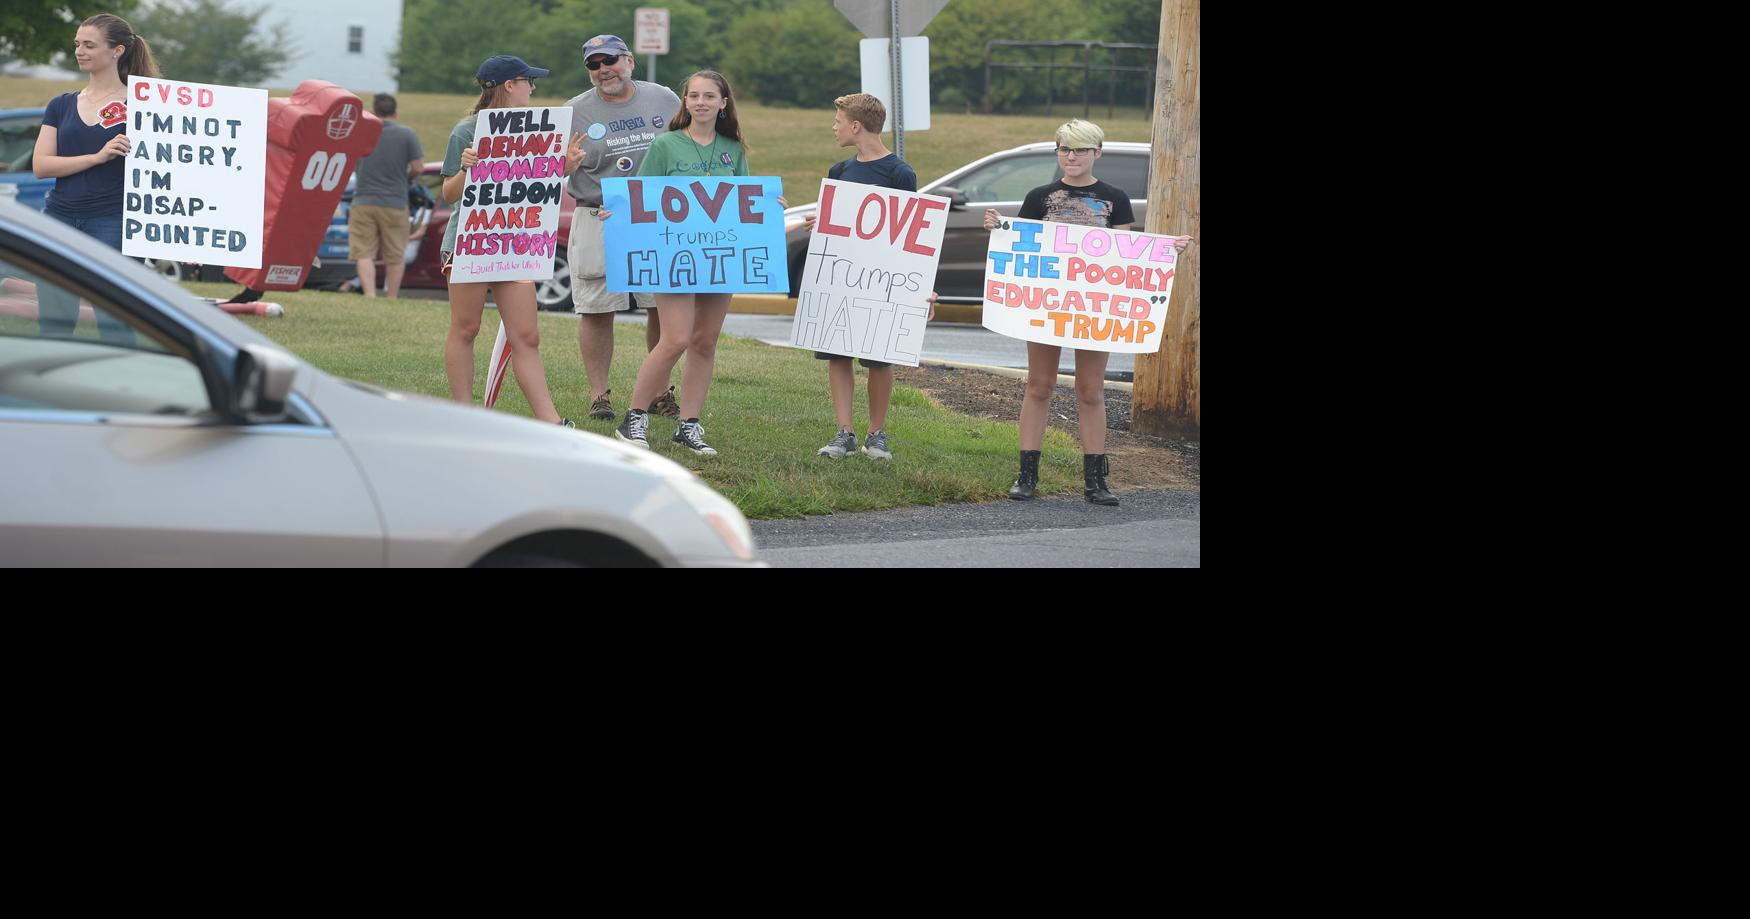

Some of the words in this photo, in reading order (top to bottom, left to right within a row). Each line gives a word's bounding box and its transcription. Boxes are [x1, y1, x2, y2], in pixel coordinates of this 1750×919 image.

[134, 82, 214, 108] CVSD
[134, 111, 173, 133] I'M
[182, 116, 242, 139] NOT
[488, 109, 556, 135] WELL
[608, 116, 646, 133] RISK
[477, 133, 563, 160] BEHAVED
[606, 136, 630, 147] Risking
[630, 133, 641, 142] the
[132, 168, 171, 190] I'M
[301, 150, 347, 192] 00
[470, 155, 567, 184] WOMEN
[126, 192, 217, 217] DISAP-
[462, 181, 562, 208] SELDOM
[627, 179, 764, 225] LOVE
[464, 206, 543, 232] MAKE
[817, 184, 947, 257] LOVE
[125, 218, 247, 252] POINTED
[455, 229, 558, 258] HISTORY
[658, 225, 738, 246] trumps
[1053, 225, 1176, 264] LOVE
[627, 246, 769, 288] HATE
[809, 237, 923, 302] trumps
[988, 250, 1060, 279] THE
[1066, 257, 1175, 292] POORLY
[795, 291, 929, 364] HATE
